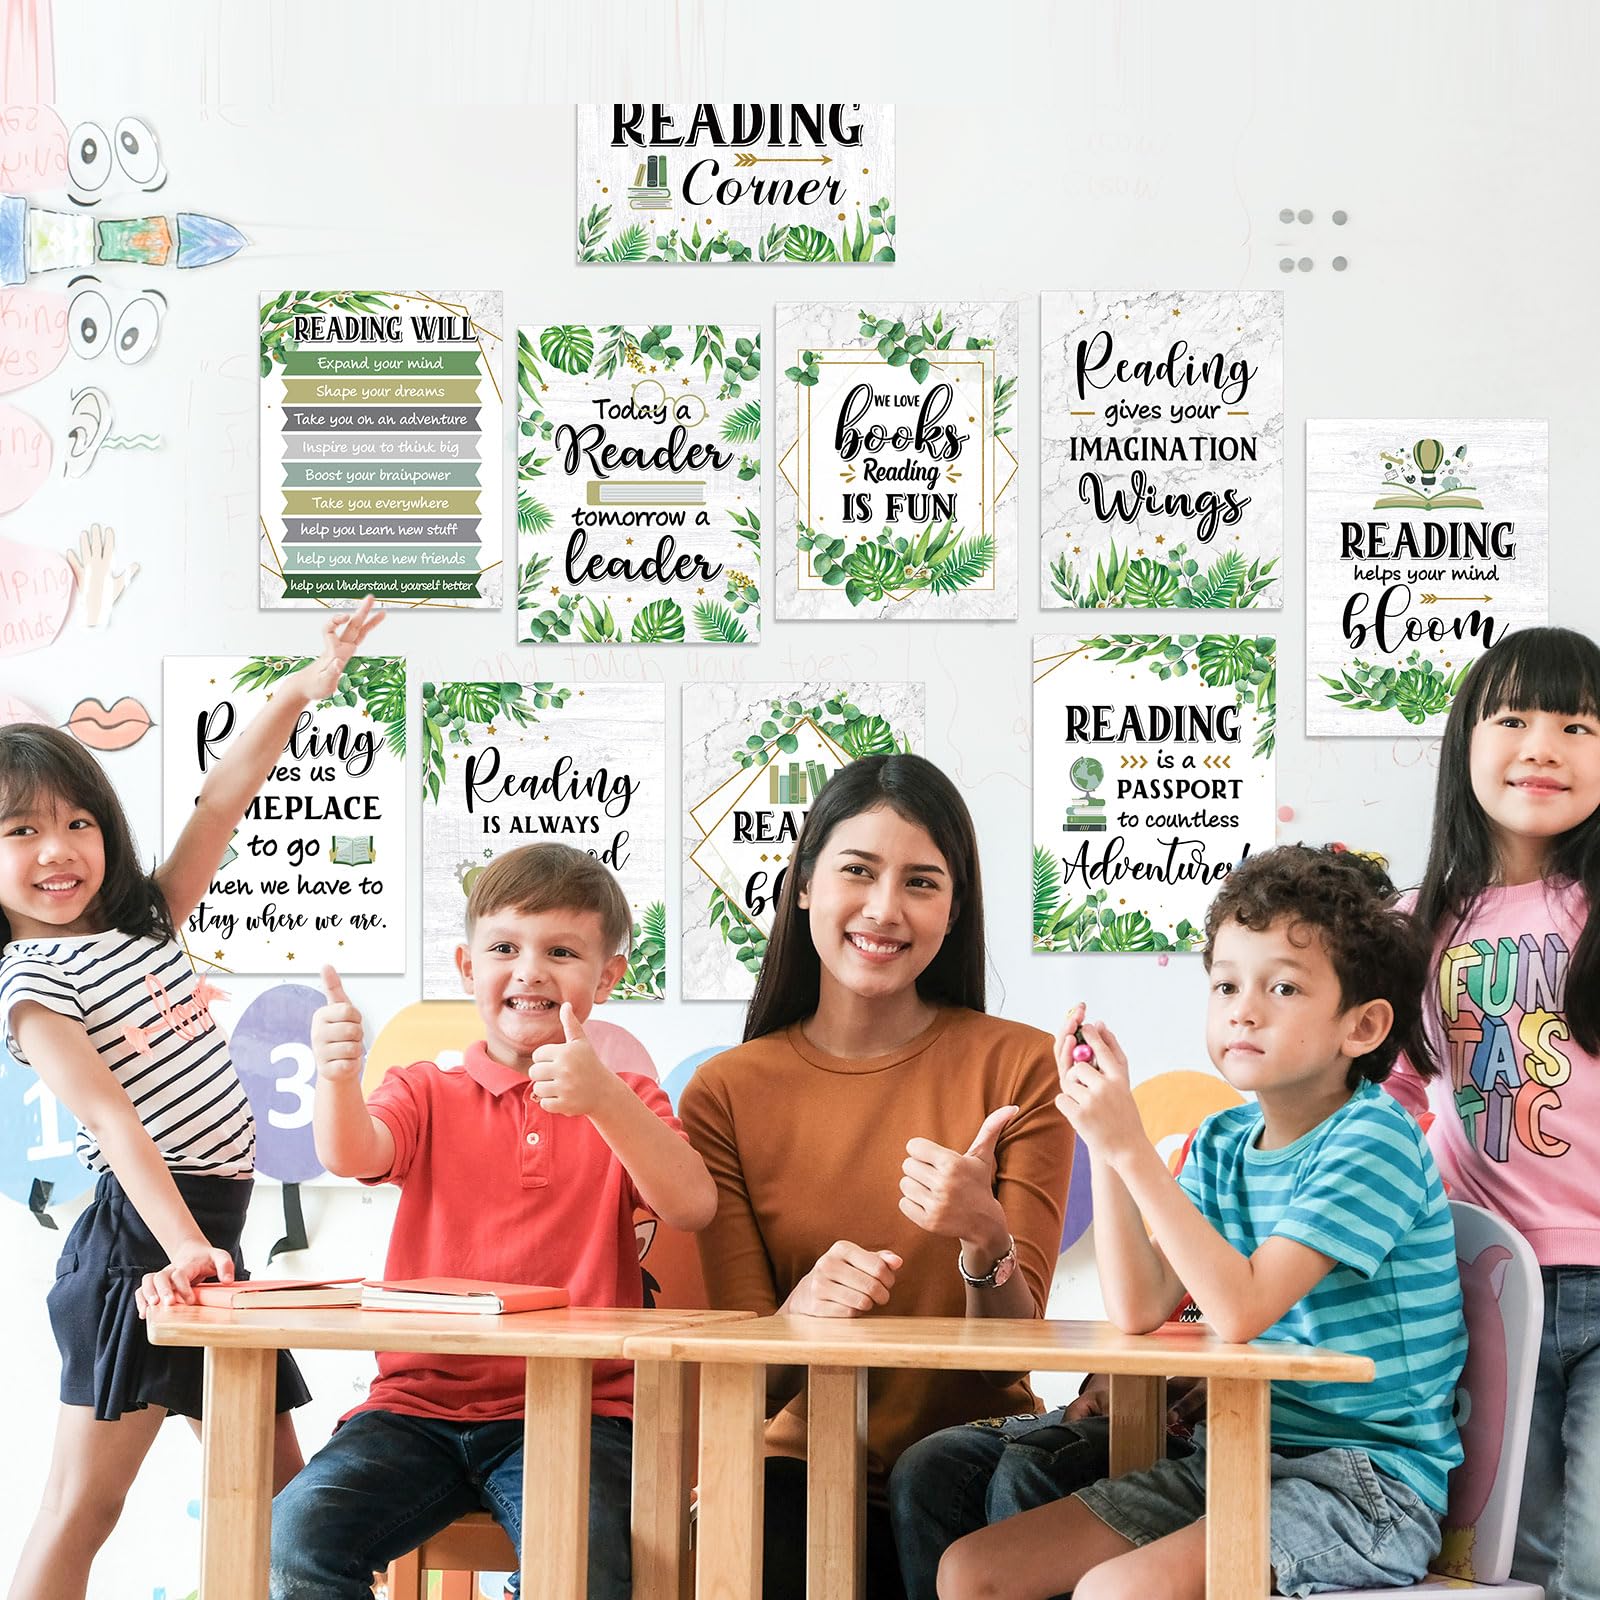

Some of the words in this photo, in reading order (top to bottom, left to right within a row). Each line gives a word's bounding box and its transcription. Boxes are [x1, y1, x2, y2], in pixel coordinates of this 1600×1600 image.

[611, 104, 863, 147] READING
[682, 158, 847, 206] Corner
[294, 315, 403, 343] READING
[411, 315, 479, 343] WILL
[317, 357, 369, 372] Expand
[374, 359, 403, 372] your
[407, 356, 444, 370] mind
[1076, 330, 1259, 405] Reading
[316, 385, 357, 401] Shape
[362, 387, 390, 399] your
[394, 385, 445, 397] dreams
[874, 395, 891, 407] WE
[895, 395, 921, 407] LOVE
[294, 413, 325, 425] Take
[330, 415, 353, 427] you
[357, 415, 373, 425] on
[379, 415, 396, 425] an
[400, 413, 467, 425] adventure
[592, 398, 667, 424] Today
[676, 406, 691, 420] a
[835, 383, 970, 461] books
[1105, 399, 1162, 427] gives
[1170, 404, 1221, 426] your
[302, 441, 347, 456] Inspire
[352, 443, 375, 455] you
[379, 441, 393, 453] to
[398, 441, 435, 453] think
[440, 441, 459, 457] big
[554, 423, 734, 479] Reader
[1070, 436, 1258, 462] IMAGINATION
[305, 469, 342, 481] Boost
[347, 471, 376, 483] your
[379, 469, 451, 484] brainpower
[863, 458, 941, 491] Reading
[312, 497, 344, 509] Take
[348, 499, 372, 511] you
[376, 498, 449, 510] everywhere
[572, 508, 686, 527] tomorrow
[695, 512, 710, 526] a
[842, 493, 873, 524] IS
[885, 493, 959, 524] FUN
[1079, 470, 1252, 544] Wings
[300, 524, 329, 538] help
[333, 526, 356, 538] you
[359, 525, 394, 536] Learn
[398, 525, 423, 536] new
[427, 524, 458, 536] stuff
[1340, 521, 1516, 560] READING
[296, 553, 325, 567] help
[329, 554, 353, 567] you
[355, 553, 388, 564] Make
[392, 554, 417, 565] new
[421, 553, 465, 564] friends
[565, 528, 724, 586] leader
[290, 580, 312, 594] help
[315, 582, 334, 594] you
[336, 580, 398, 592] Understand
[400, 580, 440, 593] yourself
[442, 580, 473, 591] better
[1354, 566, 1401, 586] helps
[1407, 569, 1447, 584] your
[1451, 565, 1500, 582] mind
[0, 610, 55, 647] ands
[1342, 583, 1510, 654] bloom
[1065, 704, 1241, 744] READING
[1156, 750, 1174, 769] is
[1182, 755, 1196, 769] a
[266, 766, 301, 782] ves
[310, 767, 336, 782] us
[465, 746, 641, 818] Reading
[1117, 779, 1243, 800] PASSPORT
[195, 795, 382, 821] MEPLACE
[1117, 811, 1139, 828] to
[1146, 810, 1239, 828] countless
[482, 815, 501, 834] IS
[509, 815, 600, 834] ALWAYS
[247, 834, 278, 856] to
[287, 838, 320, 867] go
[209, 876, 253, 895] hen
[260, 879, 290, 895] we
[297, 874, 352, 895] have
[358, 876, 384, 895] to
[189, 902, 239, 940] stay
[246, 903, 308, 930] where
[315, 913, 340, 929] we
[350, 913, 387, 930] are.
[1439, 933, 1569, 1022] FUN
[1443, 1008, 1572, 1094] TAS
[267, 1041, 316, 1129] 3
[23, 1079, 74, 1161] 1
[1453, 1080, 1571, 1162] TIC
